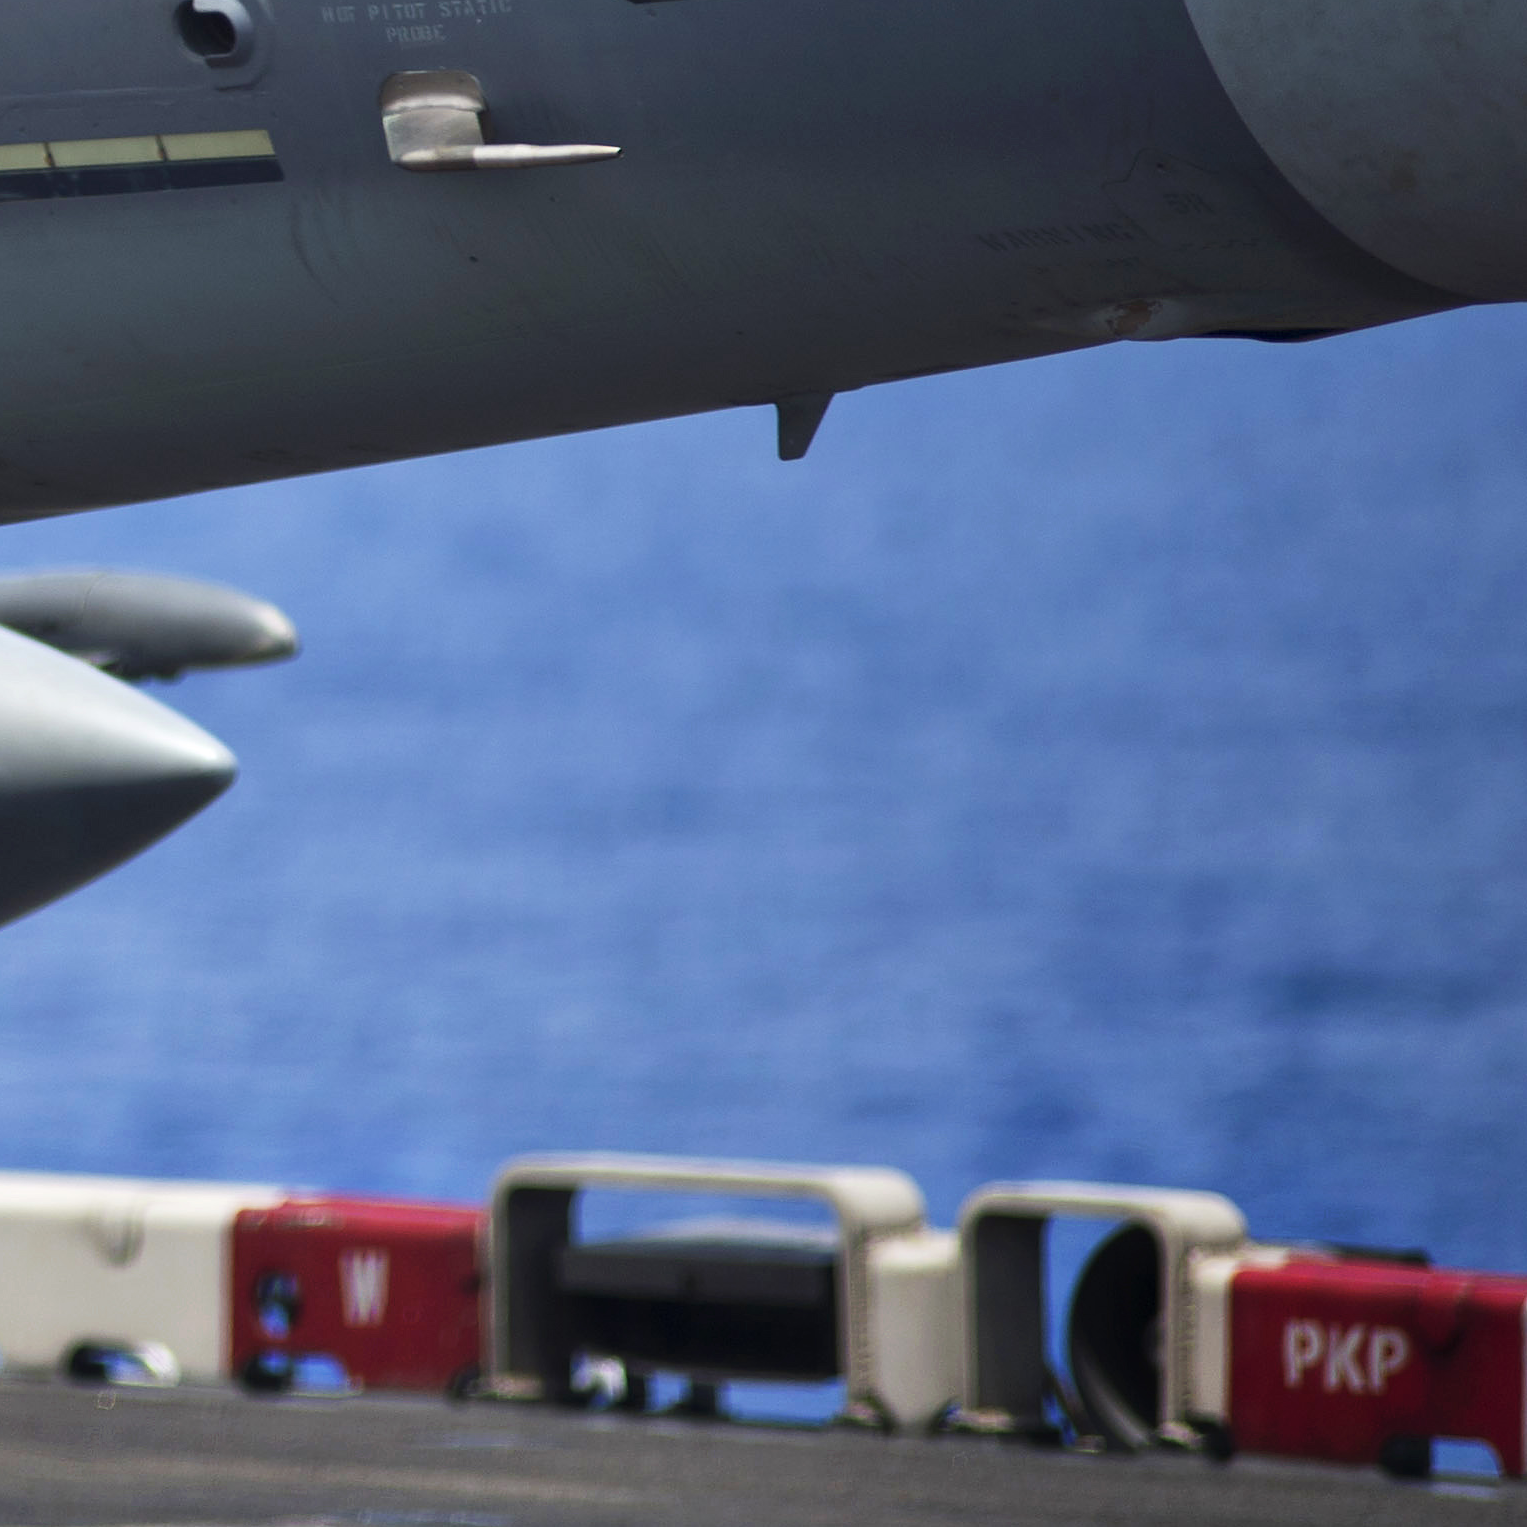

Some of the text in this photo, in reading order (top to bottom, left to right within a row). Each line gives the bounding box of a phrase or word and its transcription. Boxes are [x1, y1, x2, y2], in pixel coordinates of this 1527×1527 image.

[367, 2, 426, 20] PITOT
[384, 24, 446, 43] PROBE
[338, 1247, 391, 1326] W
[1282, 1317, 1412, 1396] PKP
